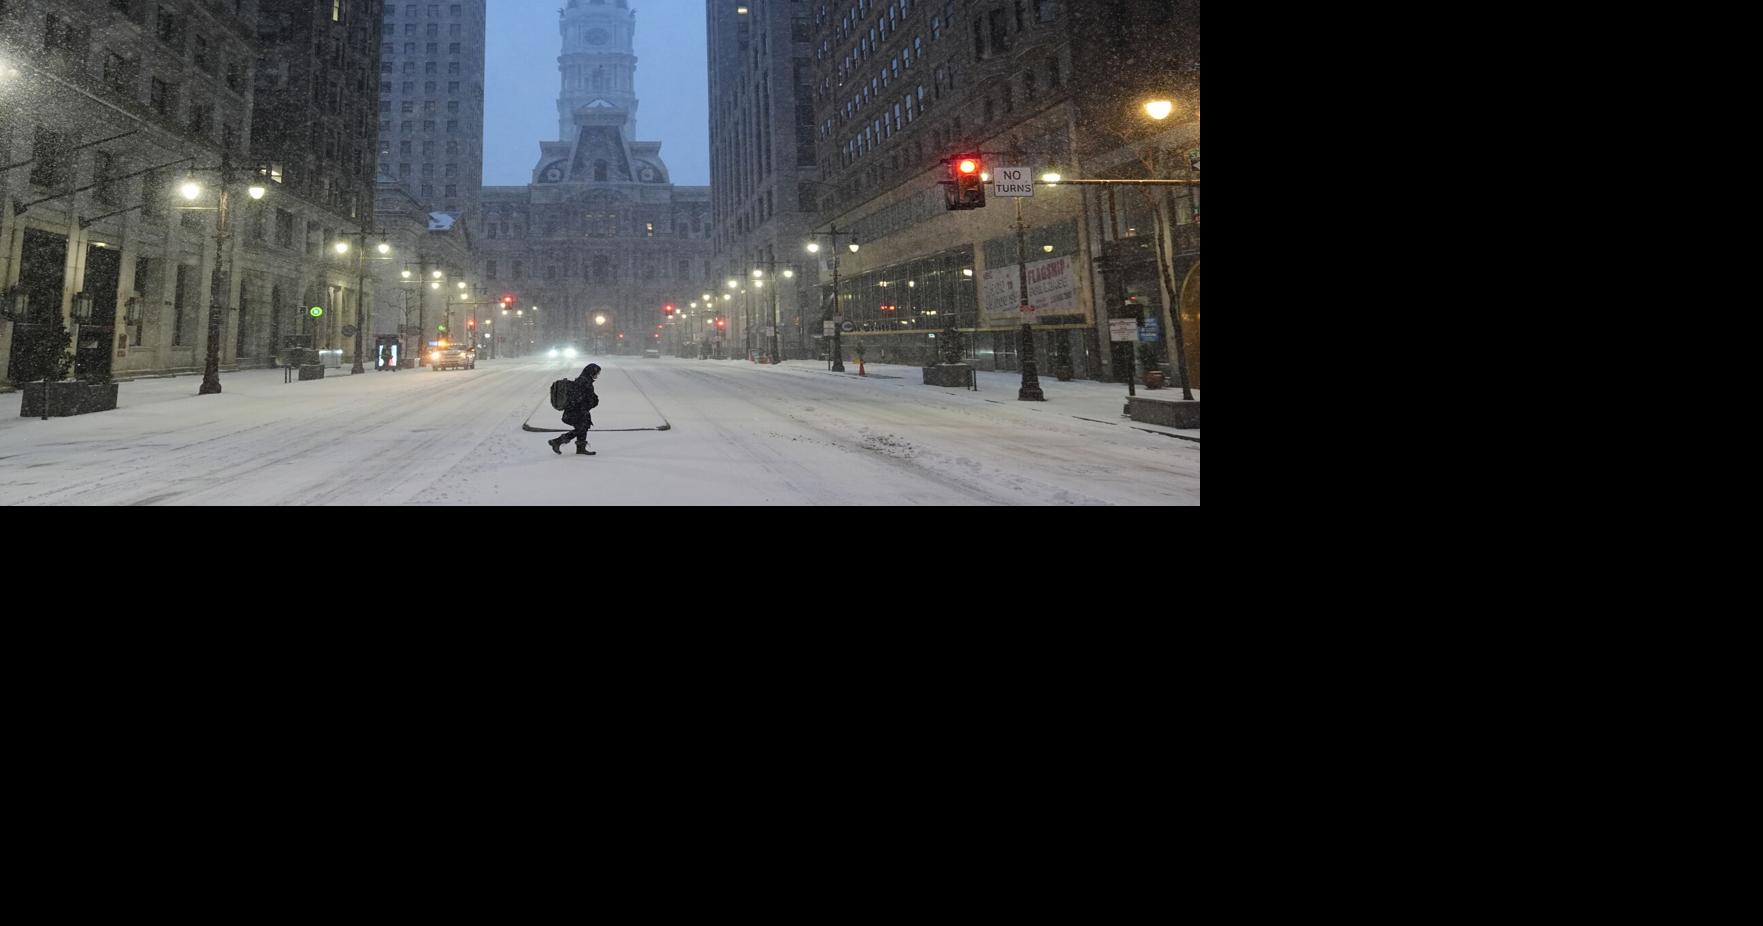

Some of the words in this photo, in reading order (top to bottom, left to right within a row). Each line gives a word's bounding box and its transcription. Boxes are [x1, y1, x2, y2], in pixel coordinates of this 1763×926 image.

[1003, 170, 1021, 180] NO
[996, 184, 1032, 193] TURNS
[1027, 259, 1064, 285] FLAGSHIP
